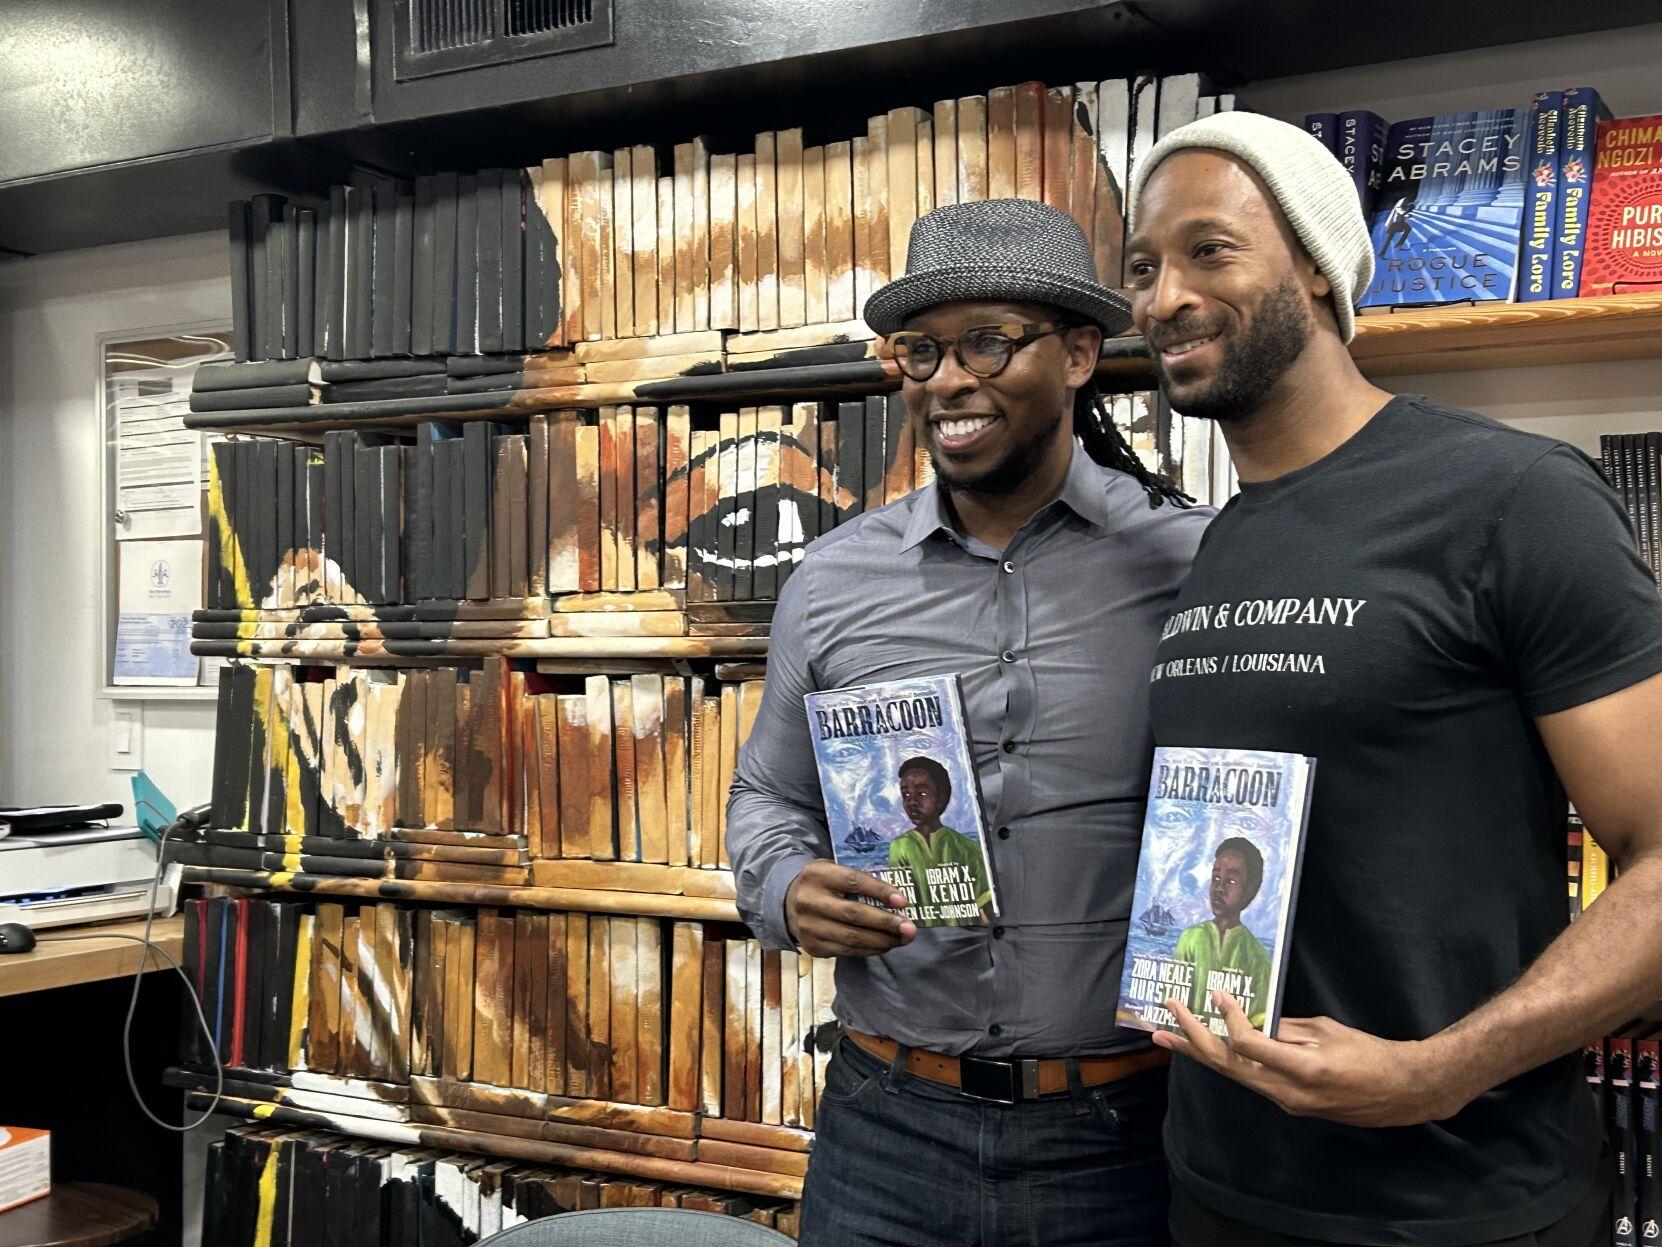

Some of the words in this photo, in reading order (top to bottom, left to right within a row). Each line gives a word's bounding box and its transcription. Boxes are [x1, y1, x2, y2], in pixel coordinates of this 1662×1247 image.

[1397, 133, 1520, 159] STACEY
[1597, 147, 1654, 169] NGOZI
[1387, 156, 1520, 182] ABRAMS
[1529, 192, 1552, 249] Family
[1560, 188, 1583, 246] Family
[1622, 204, 1662, 226] PUR
[1388, 253, 1488, 272] ROGUE
[1530, 254, 1548, 293] Lore
[1561, 250, 1580, 290] Lore
[1368, 273, 1498, 295] JUSTICE
[1214, 603, 1231, 629] &
[1234, 597, 1367, 627] COMPANY
[1165, 656, 1218, 678] ORLEANS
[1221, 655, 1230, 673] /
[1232, 653, 1326, 674] LOUISIANA
[815, 696, 943, 740] BARRACOON
[1155, 764, 1284, 808] BARRACOON
[925, 866, 960, 886] IBRAM
[961, 865, 976, 883] X.
[929, 882, 976, 903] KENDI
[919, 903, 980, 920] LEE-JOHNSON
[1131, 957, 1158, 981] ZORA
[1158, 962, 1195, 987] NEALE
[1206, 969, 1241, 995] IBRAM
[1242, 975, 1256, 998] X.
[1129, 978, 1191, 1009] HURSTON
